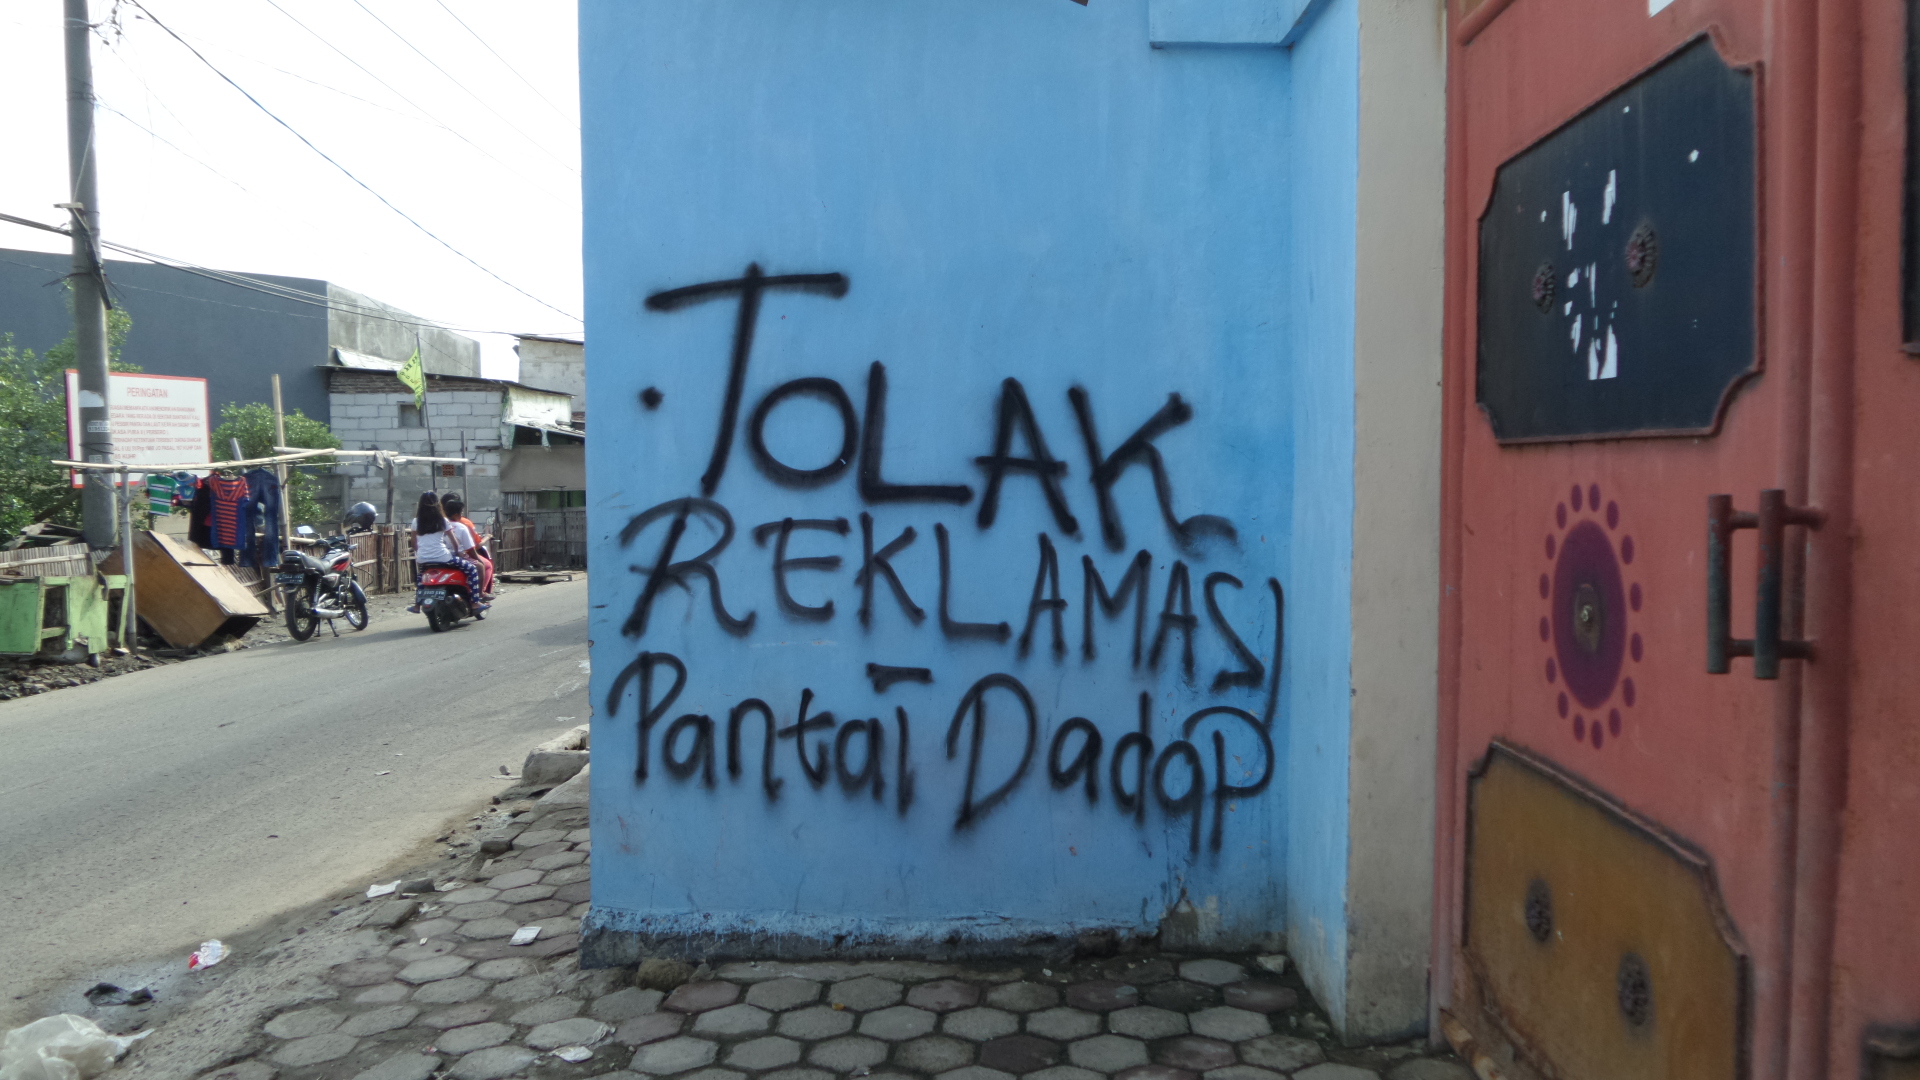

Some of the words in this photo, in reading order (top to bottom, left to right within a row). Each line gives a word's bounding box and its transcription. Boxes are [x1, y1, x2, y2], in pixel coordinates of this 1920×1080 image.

[126, 386, 169, 399] PERINGATAN
[645, 262, 1237, 558] TOLAK
[607, 650, 934, 820] Pantai
